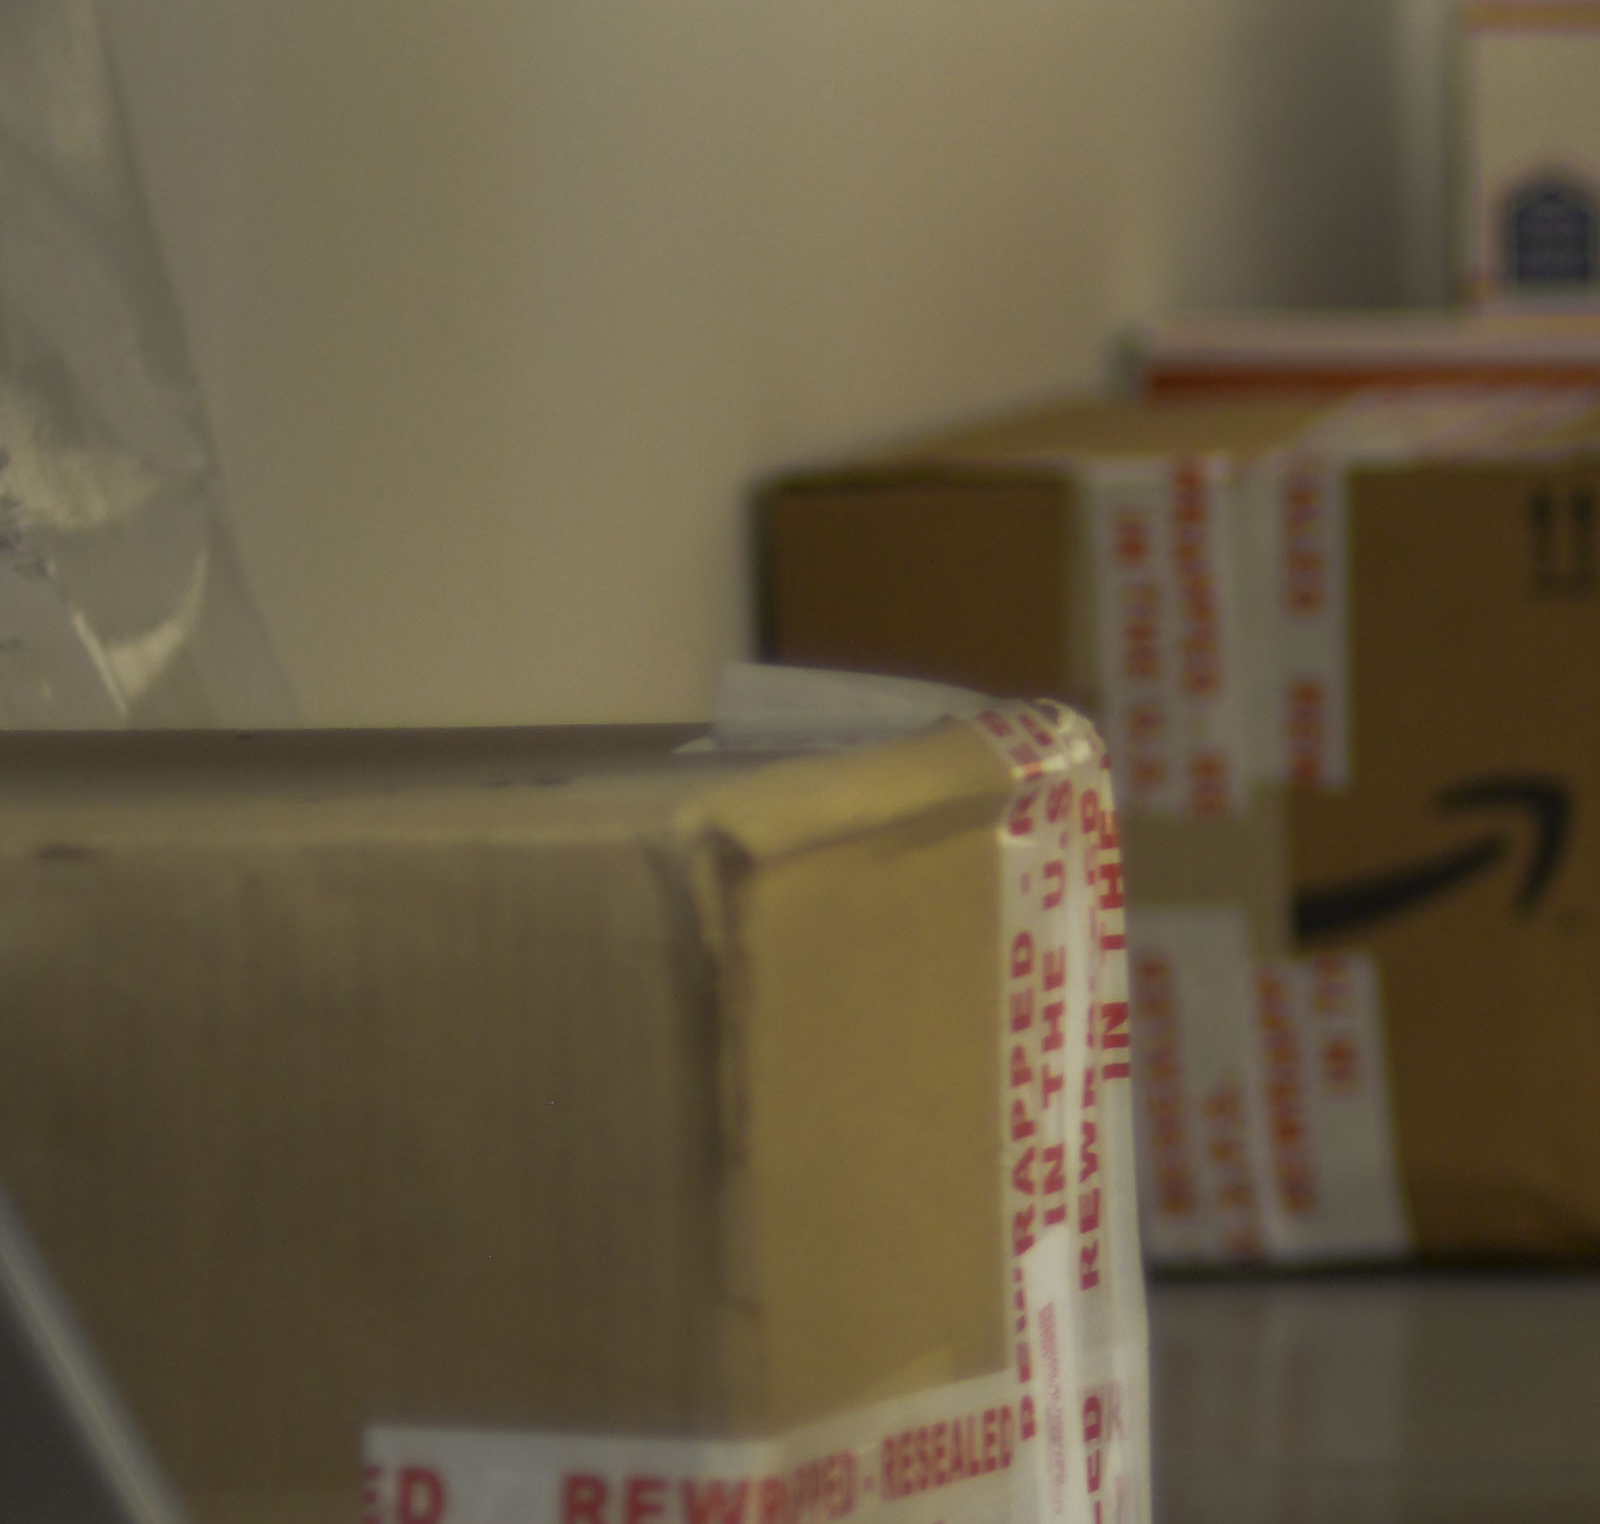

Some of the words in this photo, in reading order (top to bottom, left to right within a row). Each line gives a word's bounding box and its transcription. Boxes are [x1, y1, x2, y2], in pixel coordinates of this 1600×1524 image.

[1098, 810, 1126, 951] THE
[1042, 944, 1067, 1109] THE
[1101, 1001, 1131, 1080] IN
[1042, 1142, 1067, 1225] IN
[881, 1405, 1016, 1502] RESEALED
